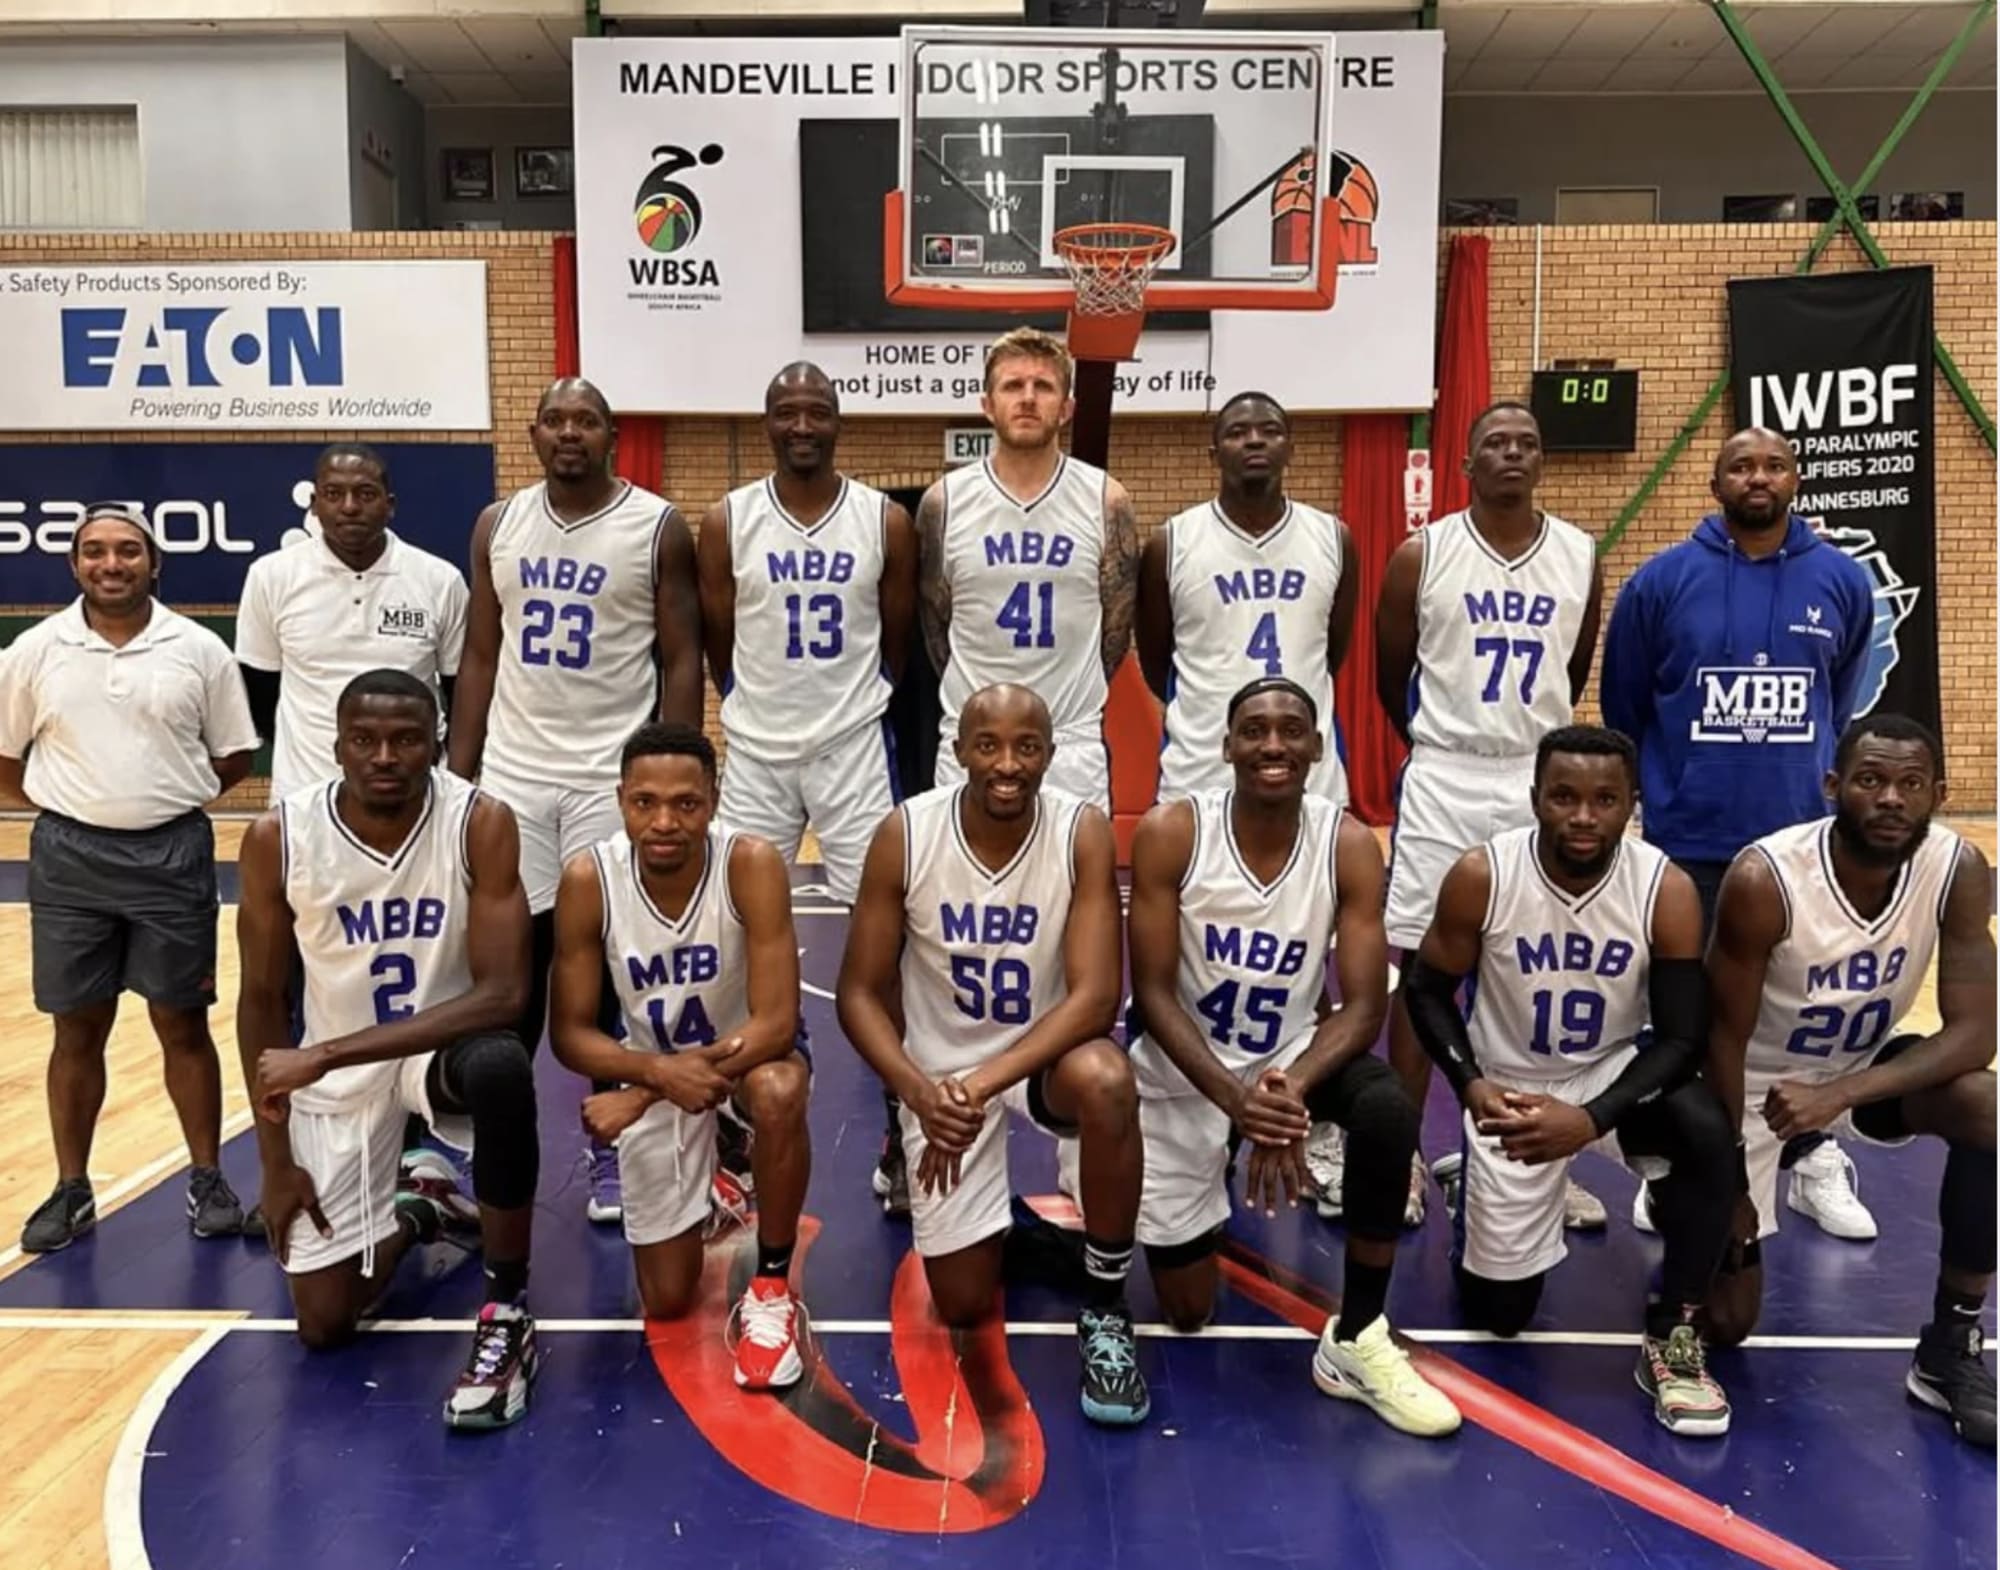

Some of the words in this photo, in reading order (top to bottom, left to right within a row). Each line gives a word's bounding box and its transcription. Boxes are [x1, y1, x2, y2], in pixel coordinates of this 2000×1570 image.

[619, 63, 874, 95] MANDEVILLE
[1056, 59, 1218, 94] SPORTS
[1231, 57, 1394, 91] CENRE
[9, 273, 70, 297] Safety
[76, 273, 161, 293] Products
[167, 272, 271, 294] Sponsored
[277, 272, 307, 295] By:
[628, 258, 720, 287] WBSA
[61, 307, 344, 388] EATON
[866, 345, 936, 365] HOME
[943, 345, 975, 365] OF
[832, 375, 870, 394] not
[876, 374, 923, 399] just
[930, 378, 943, 394] a
[951, 378, 987, 399] ga
[1113, 376, 1141, 397] ay
[1148, 371, 1173, 392] of
[1180, 371, 1217, 392] life
[1562, 379, 1609, 403] 0:0
[1750, 364, 1918, 431] IWBF
[130, 398, 221, 420] Powering
[229, 398, 319, 418] Business
[327, 397, 432, 418] Worldwide
[954, 434, 993, 458] EXIT
[1805, 430, 1920, 456] PARALYMPIC
[1796, 459, 1862, 480] LIFIERS
[1866, 455, 1915, 476] 2020
[1787, 487, 1910, 513] HANNESBURG
[767, 549, 855, 584] MBB
[984, 531, 1074, 568] MBB
[519, 556, 608, 597] MBB
[1214, 568, 1306, 604] MBB
[383, 609, 424, 628] MBB
[785, 593, 844, 660] 13
[996, 581, 1055, 649] 41
[1464, 590, 1557, 627] MBB
[521, 599, 594, 670] 23
[1246, 611, 1283, 675] 4
[1475, 637, 1545, 705] 77
[1703, 674, 1808, 716] MBB
[1703, 715, 1806, 728] BASKETBALL
[337, 897, 445, 945] MBB
[940, 902, 1039, 945] MBB
[1205, 924, 1308, 977] MBB
[1516, 932, 1634, 978] MBB
[1807, 945, 1908, 994] MBB
[370, 952, 417, 1026] 2
[950, 954, 1032, 1025] 58
[647, 995, 716, 1054] 14
[1196, 978, 1290, 1055] 45
[1529, 989, 1606, 1056] 19
[1786, 997, 1893, 1058] 20
